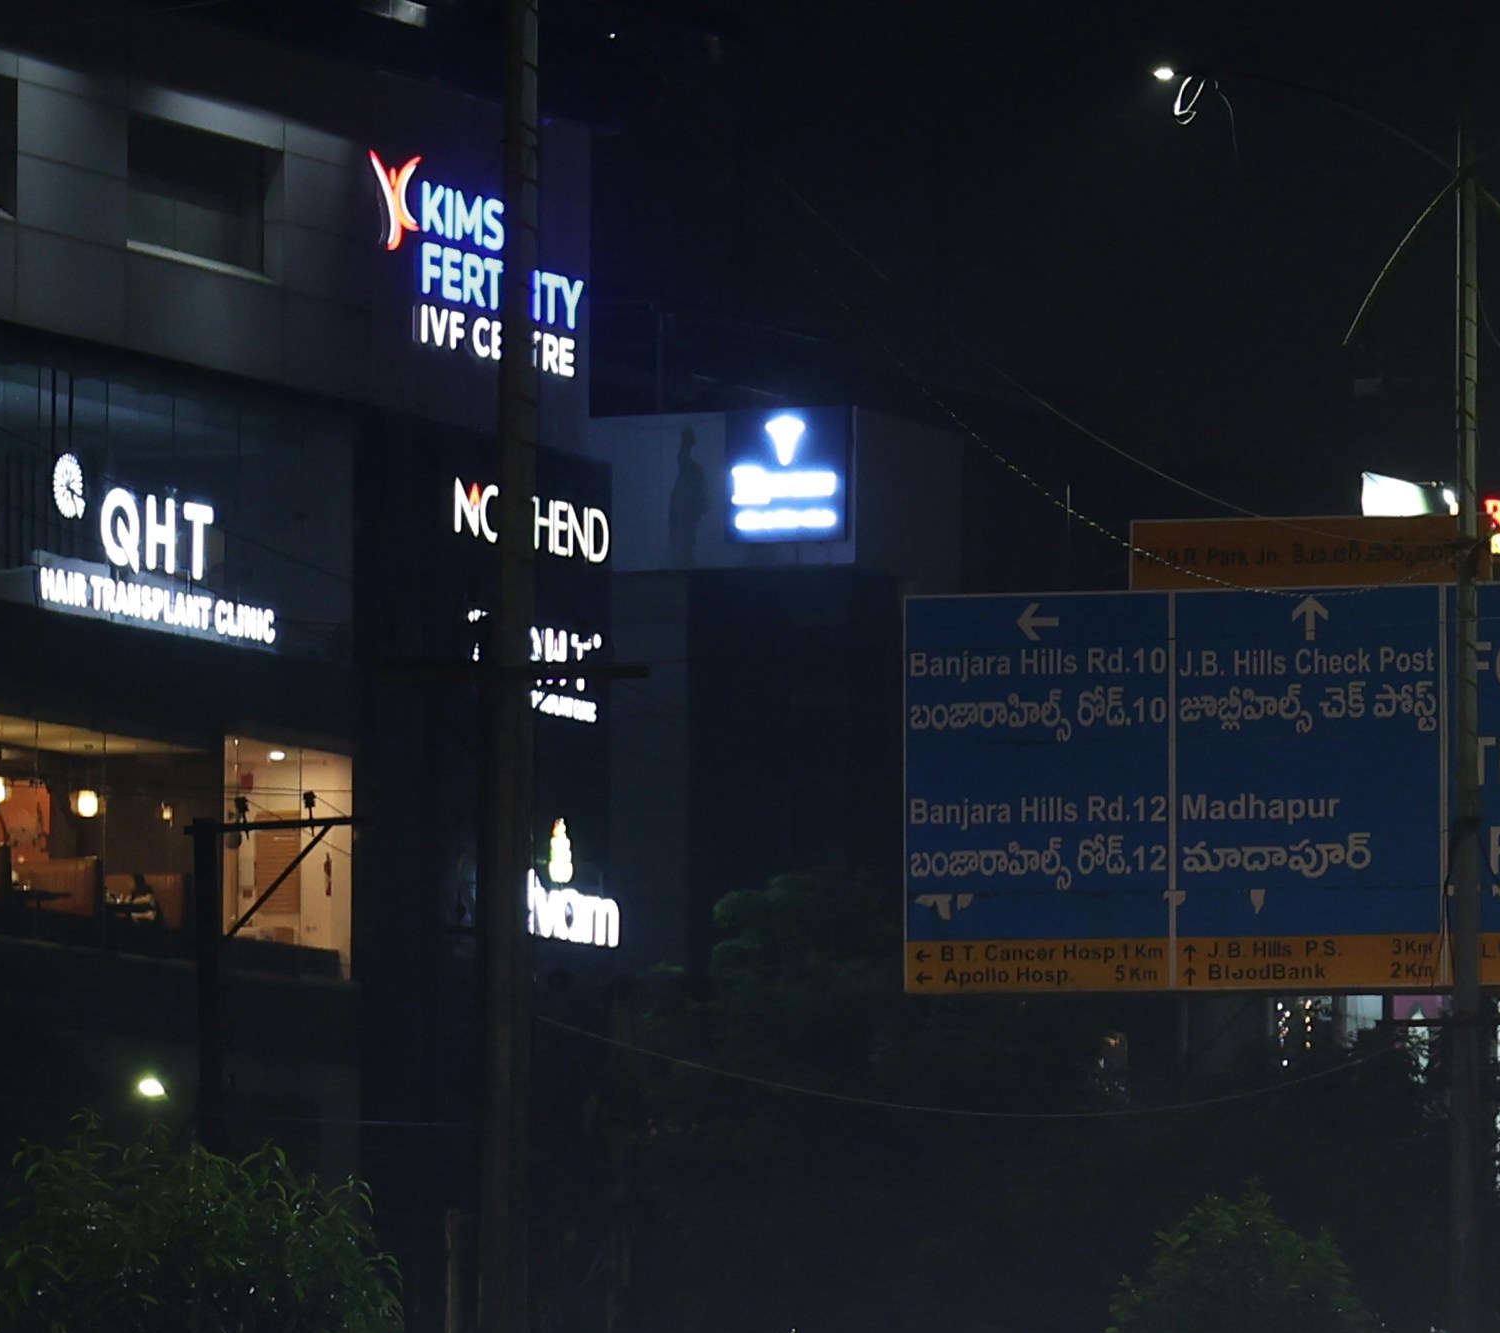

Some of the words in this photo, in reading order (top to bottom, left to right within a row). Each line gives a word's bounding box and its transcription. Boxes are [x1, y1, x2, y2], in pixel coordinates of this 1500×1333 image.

[421, 180, 505, 251] KIMS
[421, 242, 584, 330] FERTITY
[420, 303, 465, 350] IVF
[101, 487, 214, 581] QHT
[1207, 546, 1248, 566] Park
[40, 567, 88, 608] HAIR
[90, 575, 212, 631] TRANSPLANT
[215, 599, 276, 644] CLINIC
[910, 651, 1011, 683] Banjara
[1020, 648, 1078, 675] Hills
[1087, 647, 1168, 674] Rd.10
[1179, 650, 1225, 677] J.B.
[1234, 649, 1286, 675] Hills
[1295, 648, 1371, 675] Check
[1380, 647, 1435, 672] Post
[1319, 681, 1367, 718] చెక్
[910, 799, 1011, 830] Banjara
[1020, 797, 1078, 823] Hills
[1087, 796, 1168, 823] Rd.12
[1182, 794, 1341, 825] Madhapur
[985, 944, 1055, 961] Cancer
[1135, 944, 1163, 959] Km
[1253, 940, 1292, 957] Hills
[944, 967, 1009, 986] Apollo
